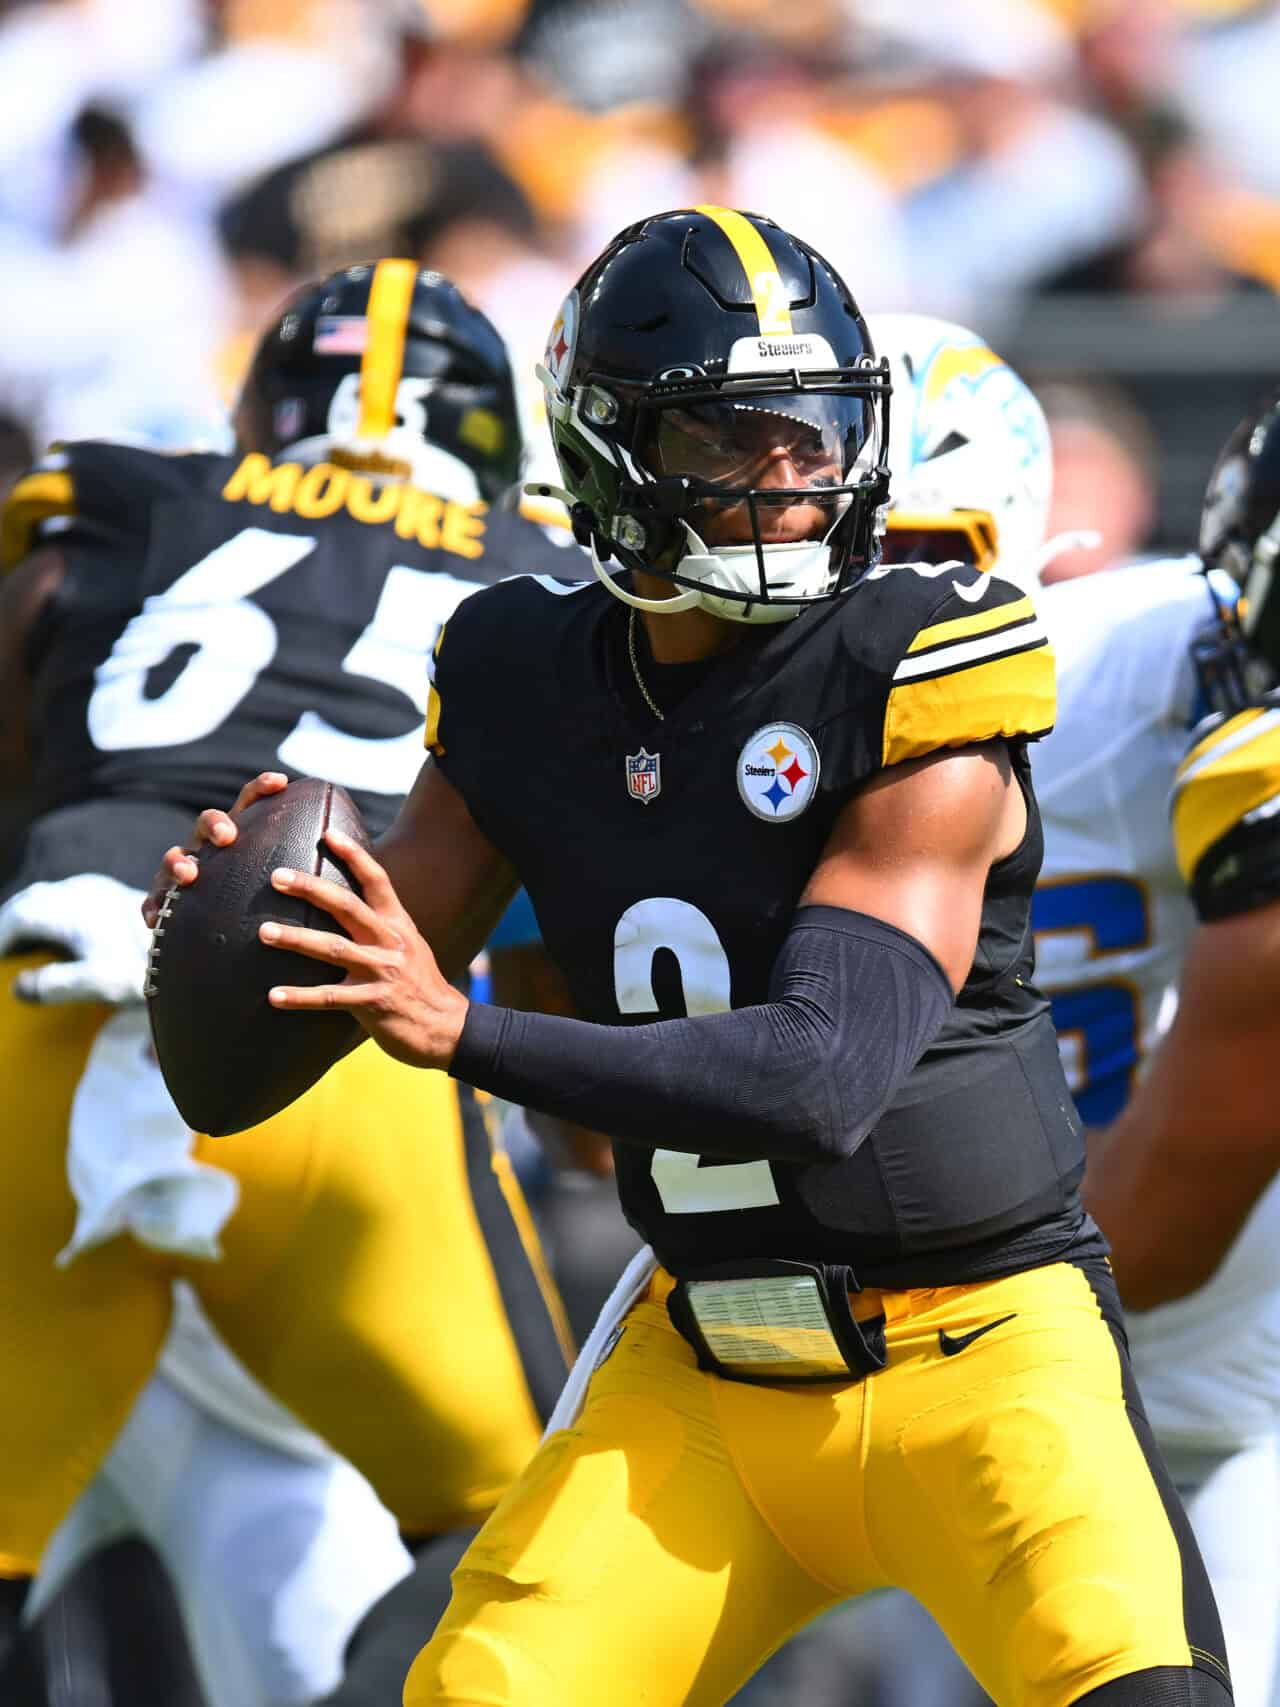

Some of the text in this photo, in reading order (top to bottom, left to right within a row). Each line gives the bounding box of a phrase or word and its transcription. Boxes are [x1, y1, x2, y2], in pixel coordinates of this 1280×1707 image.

[757, 340, 813, 358] Steelers
[223, 452, 488, 559] MOORE
[744, 764, 776, 777] Steelers
[631, 772, 656, 794] NFL
[613, 897, 781, 1214] 2
